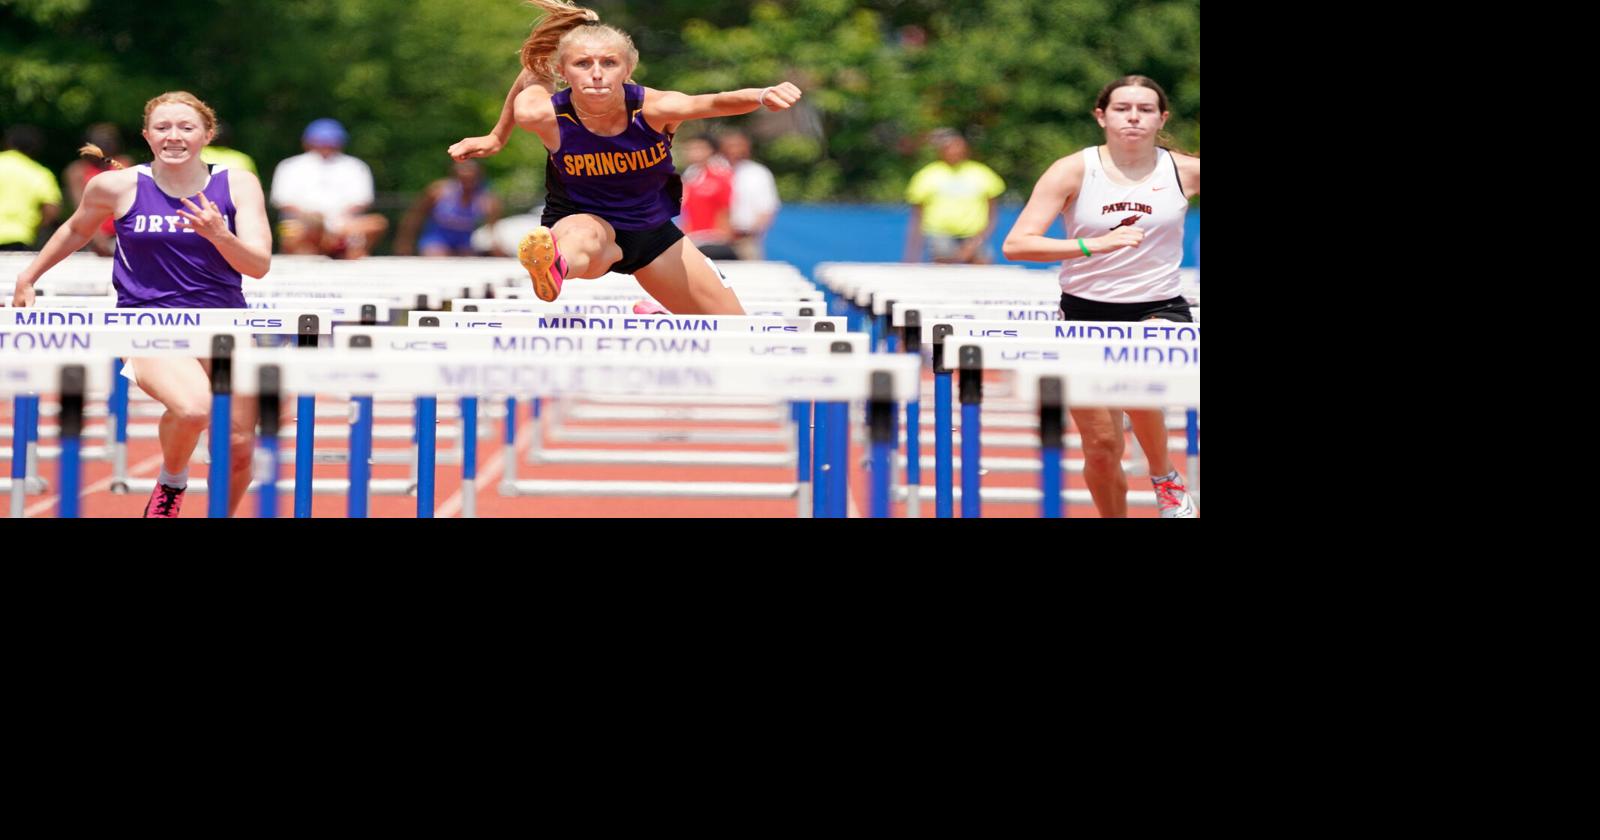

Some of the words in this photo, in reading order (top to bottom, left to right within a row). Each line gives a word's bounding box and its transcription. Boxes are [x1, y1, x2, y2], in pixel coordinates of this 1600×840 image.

[563, 141, 668, 177] SPRINGVILLE
[1101, 202, 1153, 216] PAWLING
[15, 311, 201, 326] MIDDLETOWN
[233, 318, 283, 328] UCS
[538, 317, 718, 331] MIDDLETOWN
[1055, 325, 1200, 341] MIDDLETO
[131, 338, 190, 349] UCS
[391, 340, 448, 351] UCS
[493, 335, 711, 353] MIDDLETOWN
[1001, 350, 1060, 361] UCS
